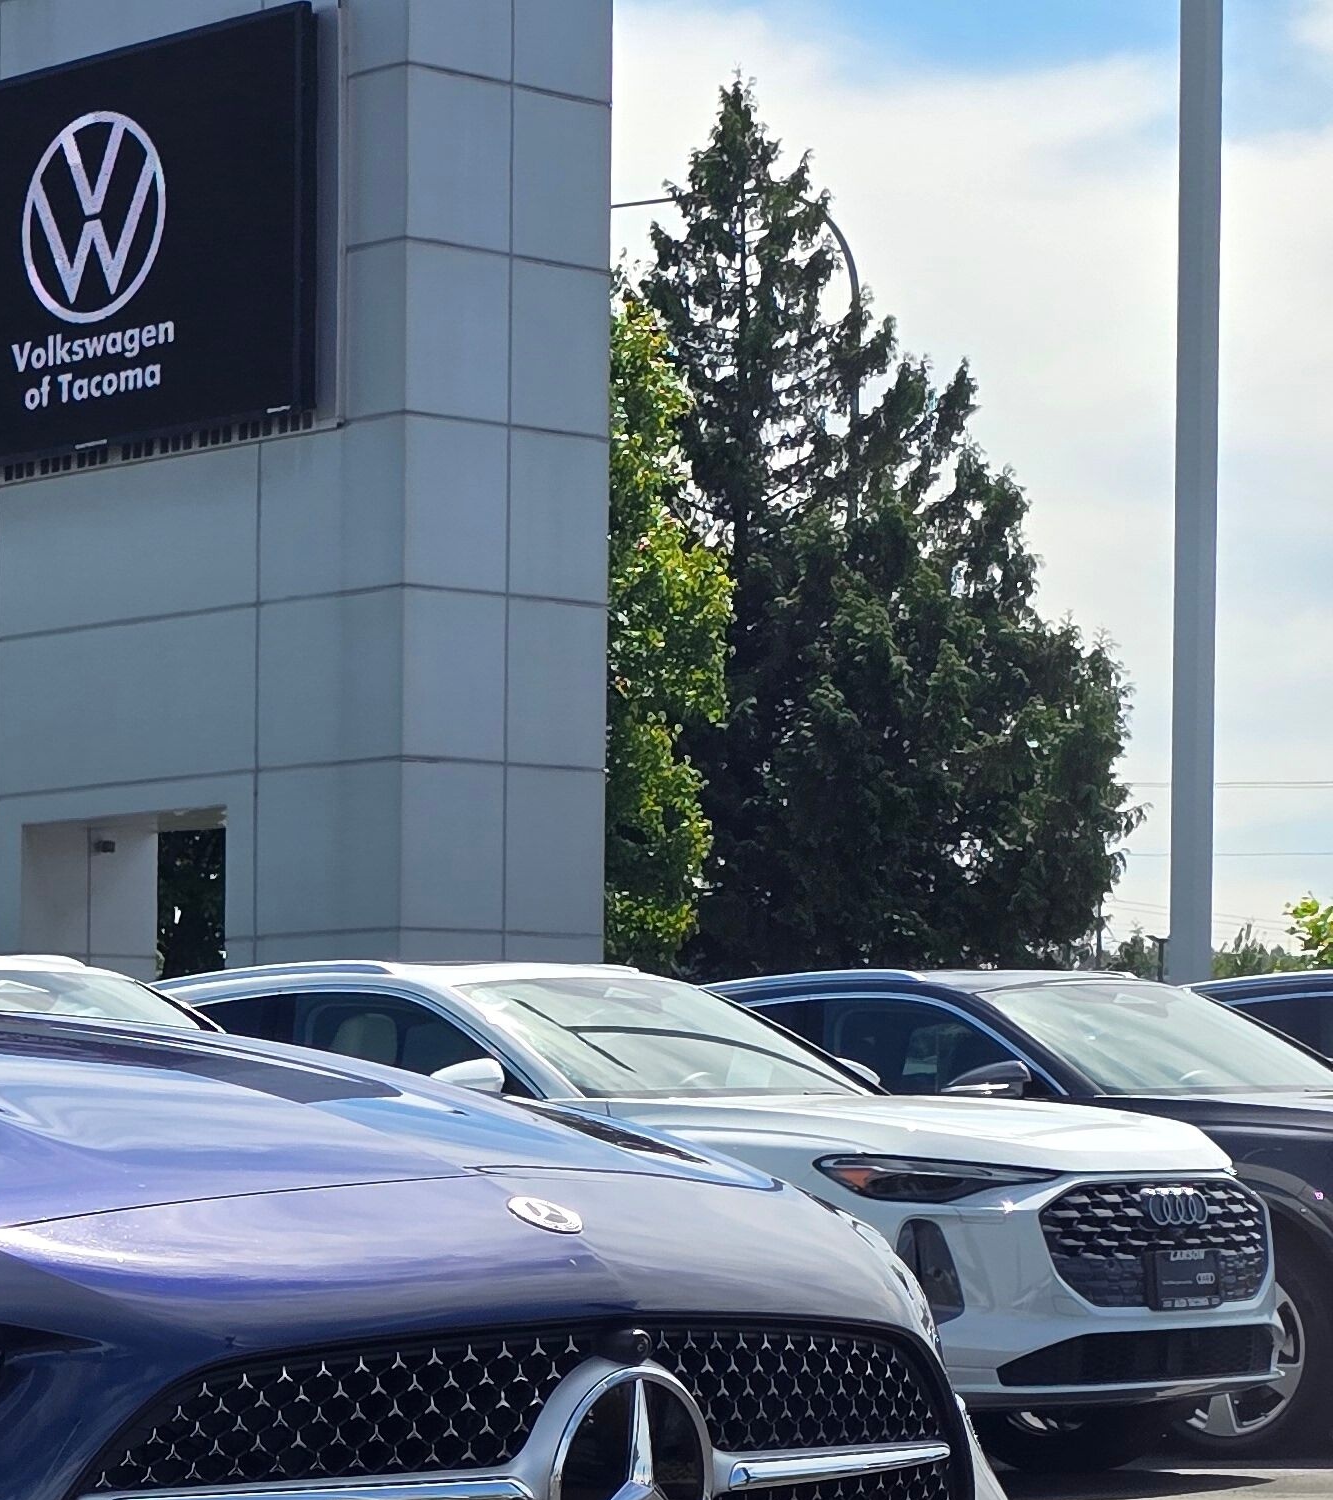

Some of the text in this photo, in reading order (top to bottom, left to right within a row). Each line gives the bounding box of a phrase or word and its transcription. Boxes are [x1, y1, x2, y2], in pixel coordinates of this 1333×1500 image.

[32, 117, 158, 304] VW
[11, 320, 175, 373] Volkswagen
[24, 363, 162, 410] of Tacoma
